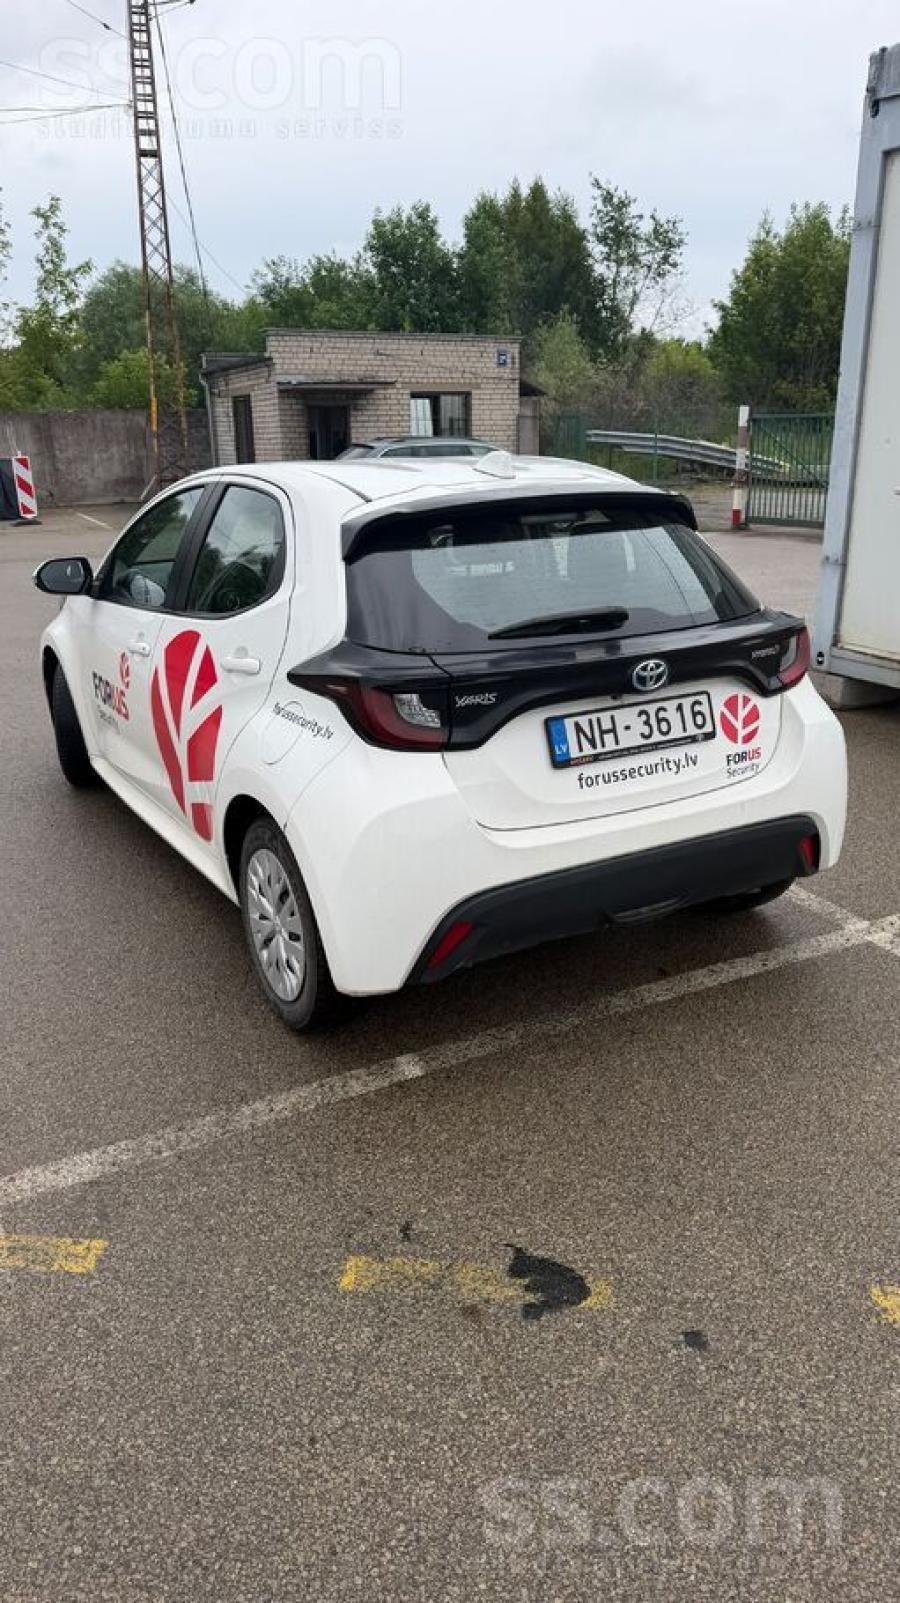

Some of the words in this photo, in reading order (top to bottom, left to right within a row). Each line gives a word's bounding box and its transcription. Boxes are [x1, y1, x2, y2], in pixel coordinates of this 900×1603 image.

[92, 670, 129, 720] FORUS
[272, 702, 334, 739] forussecurity.lv
[574, 700, 707, 752] NH-3616
[554, 744, 567, 755] LV
[726, 746, 761, 767] FORUS
[726, 760, 760, 774] Security
[577, 752, 698, 789] forussecurity.lv
